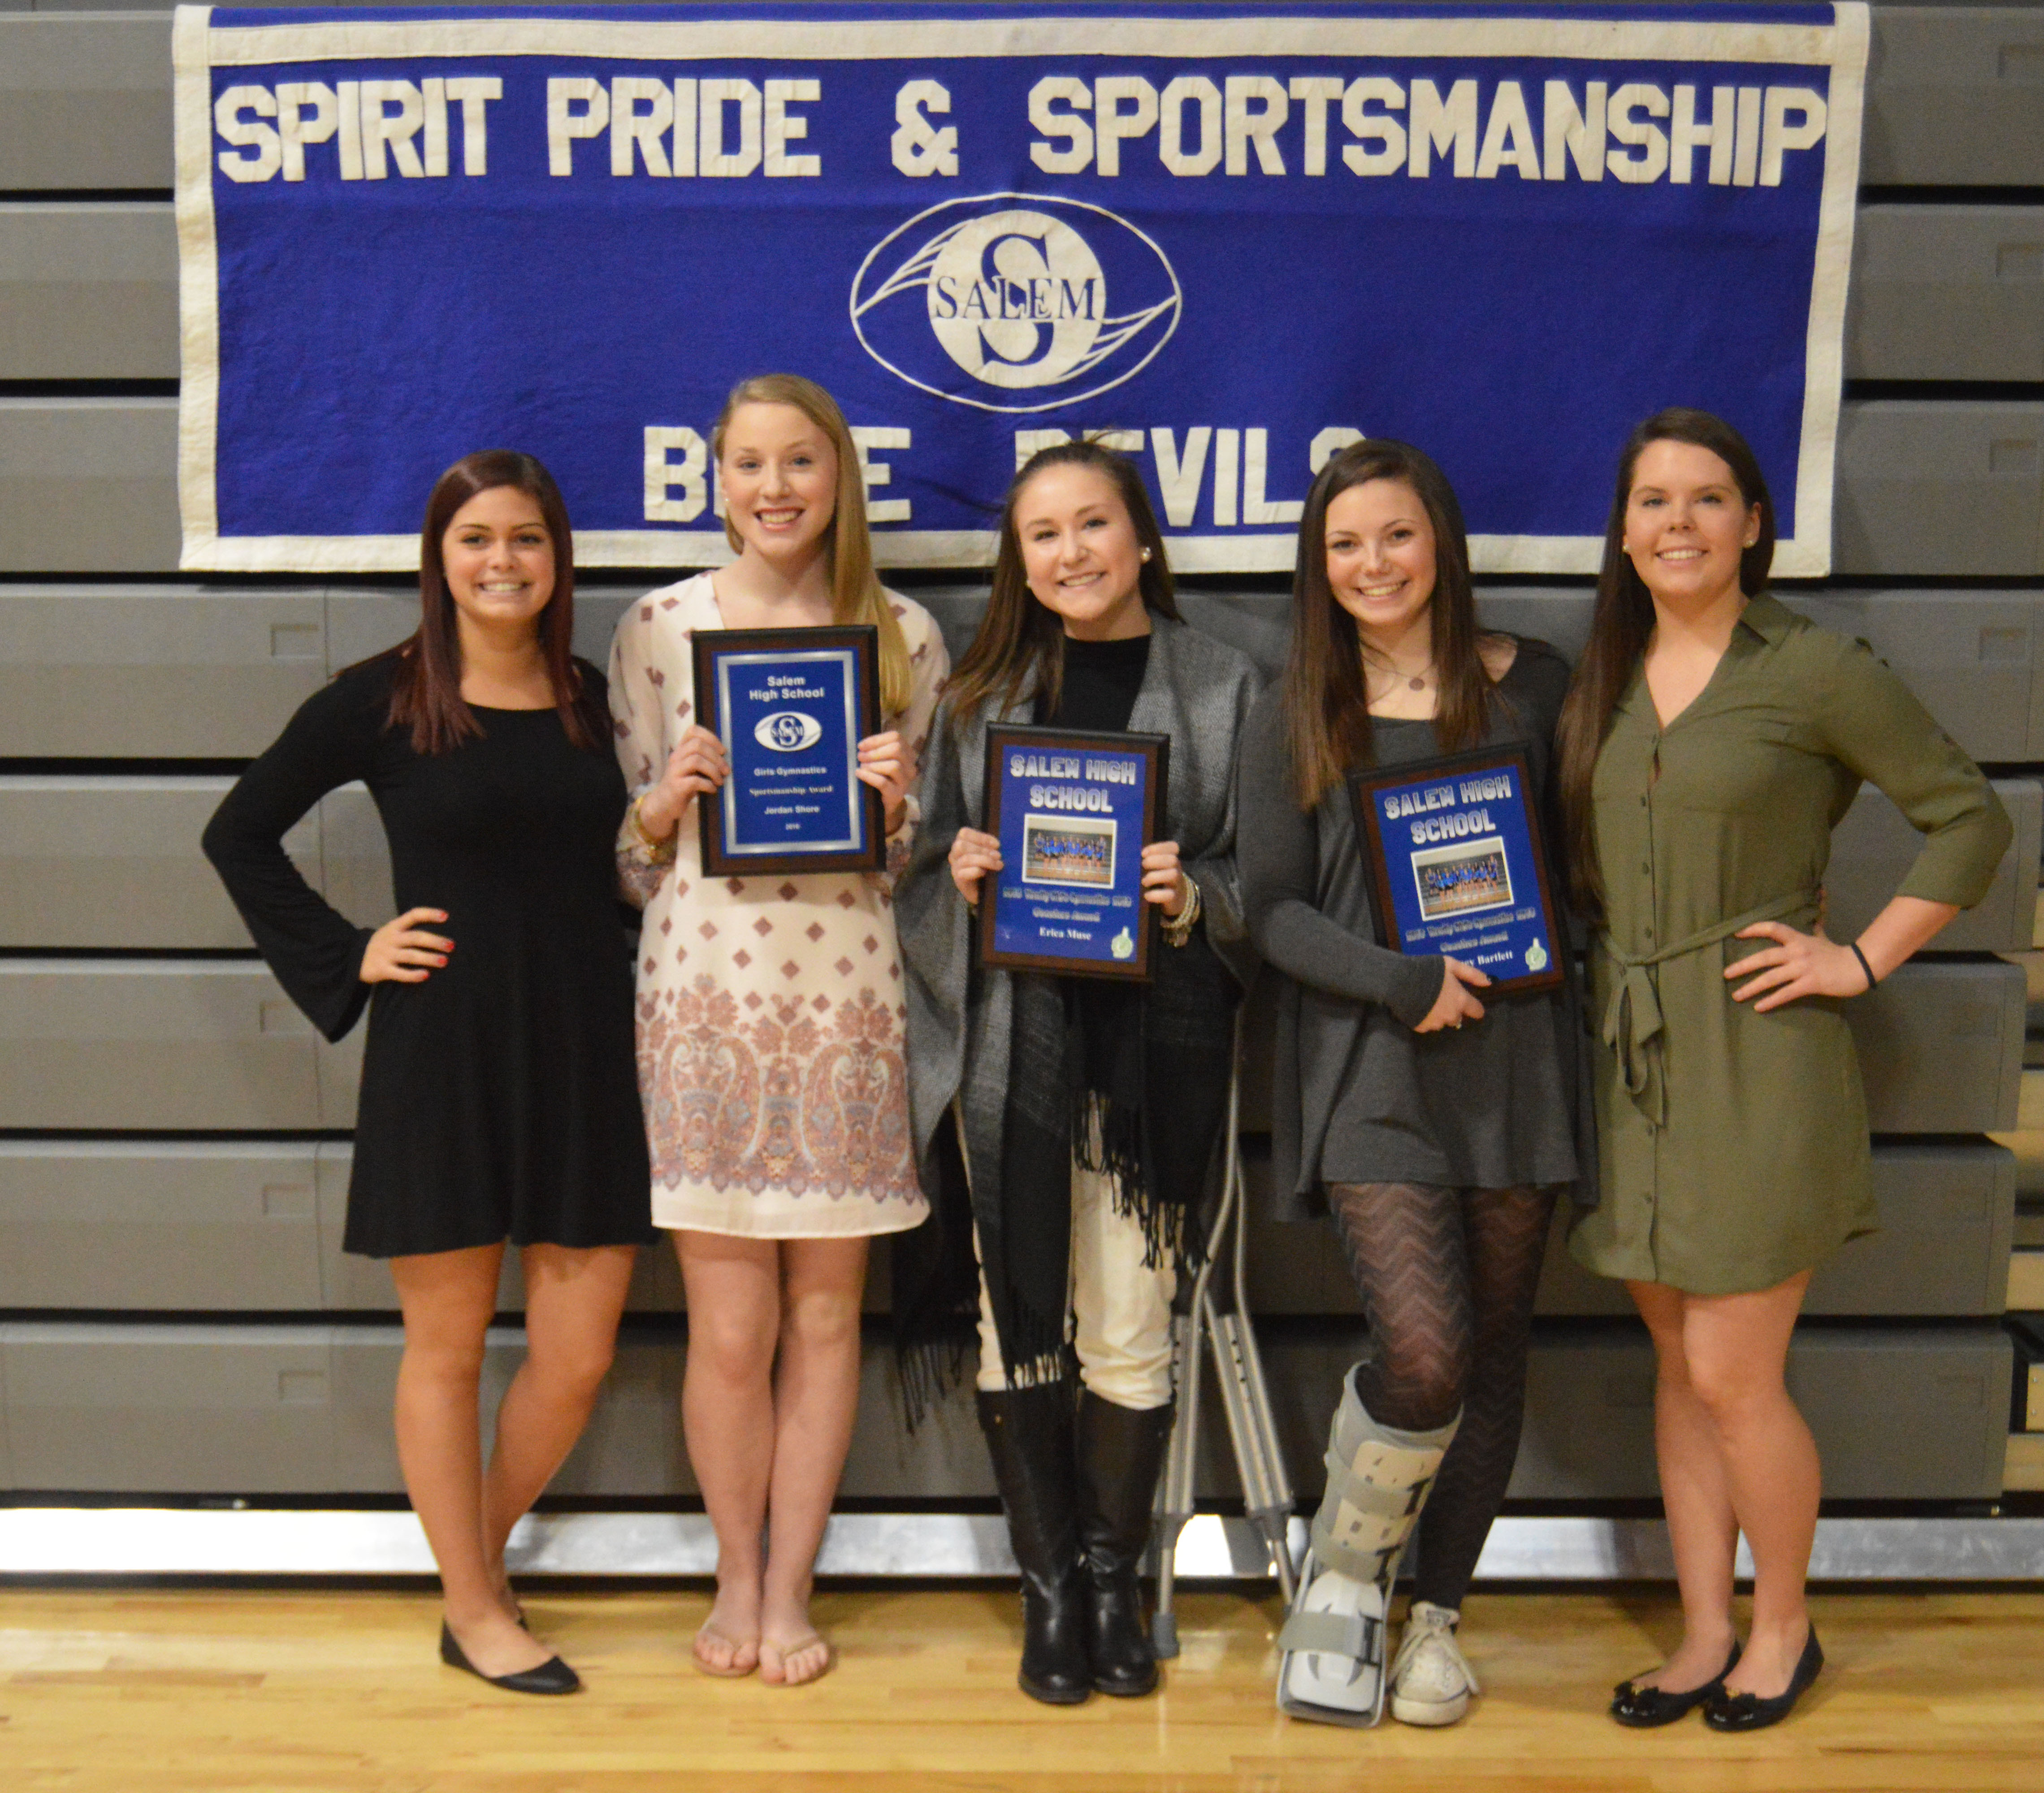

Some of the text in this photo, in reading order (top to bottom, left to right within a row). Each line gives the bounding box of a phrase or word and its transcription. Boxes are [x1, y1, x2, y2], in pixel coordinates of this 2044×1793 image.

[215, 75, 1827, 187] SPIRIT PRIDE & SPORTSMANSHIP
[936, 275, 1096, 320] SALEM
[643, 426, 912, 523] BE
[767, 676, 805, 687] Salem
[749, 687, 825, 702] High School
[754, 767, 827, 777] Girls Gymnastics
[1010, 755, 1136, 785] SALEM HIGH
[749, 787, 806, 797] Sportsmanship
[1030, 785, 1113, 813] SCHOOL
[1384, 775, 1512, 820] SALEM HIGH
[764, 806, 793, 815] Jordan
[1411, 808, 1496, 845] SCHOOL
[1039, 927, 1091, 940] Erica Muse
[1477, 950, 1513, 966] Bartlett
